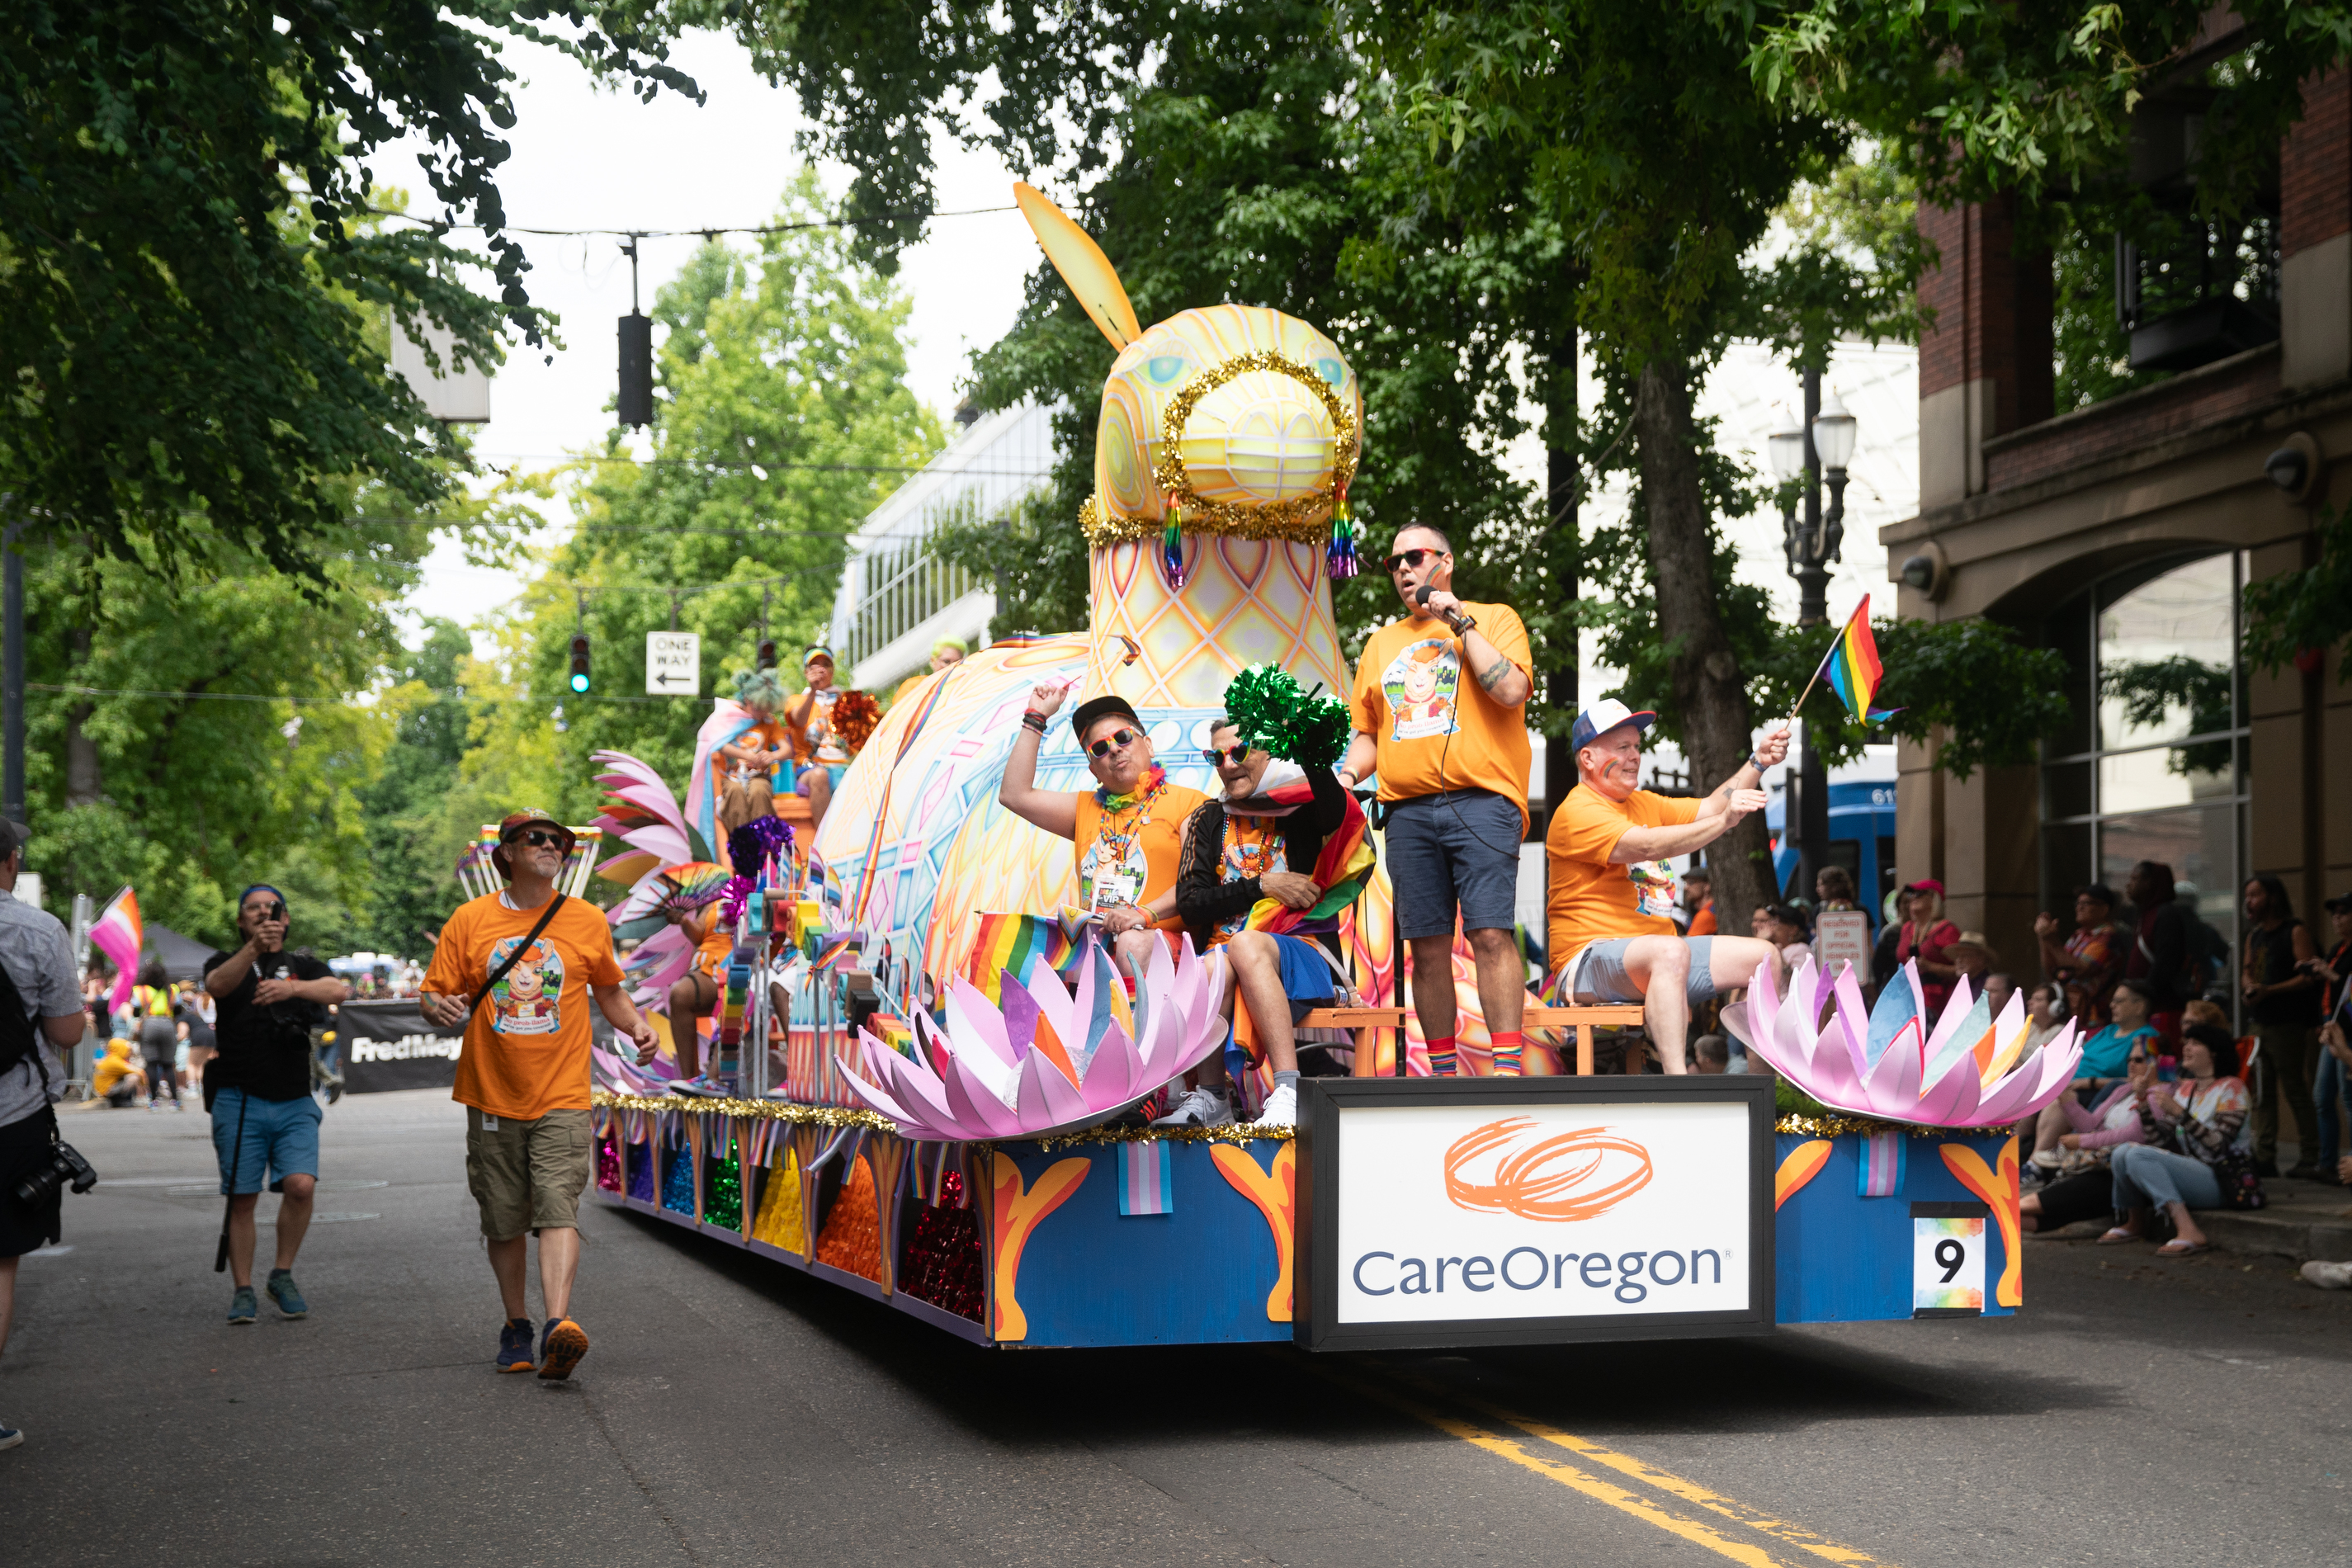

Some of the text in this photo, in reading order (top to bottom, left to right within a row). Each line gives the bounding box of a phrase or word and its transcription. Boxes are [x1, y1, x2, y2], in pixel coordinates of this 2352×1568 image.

[655, 637, 692, 652] ONE
[655, 654, 692, 667] WAY
[1872, 788, 1897, 805] 61
[1103, 895, 1120, 904] VIP
[1823, 919, 1860, 928] RESERVED
[1934, 1239, 1965, 1283] 9
